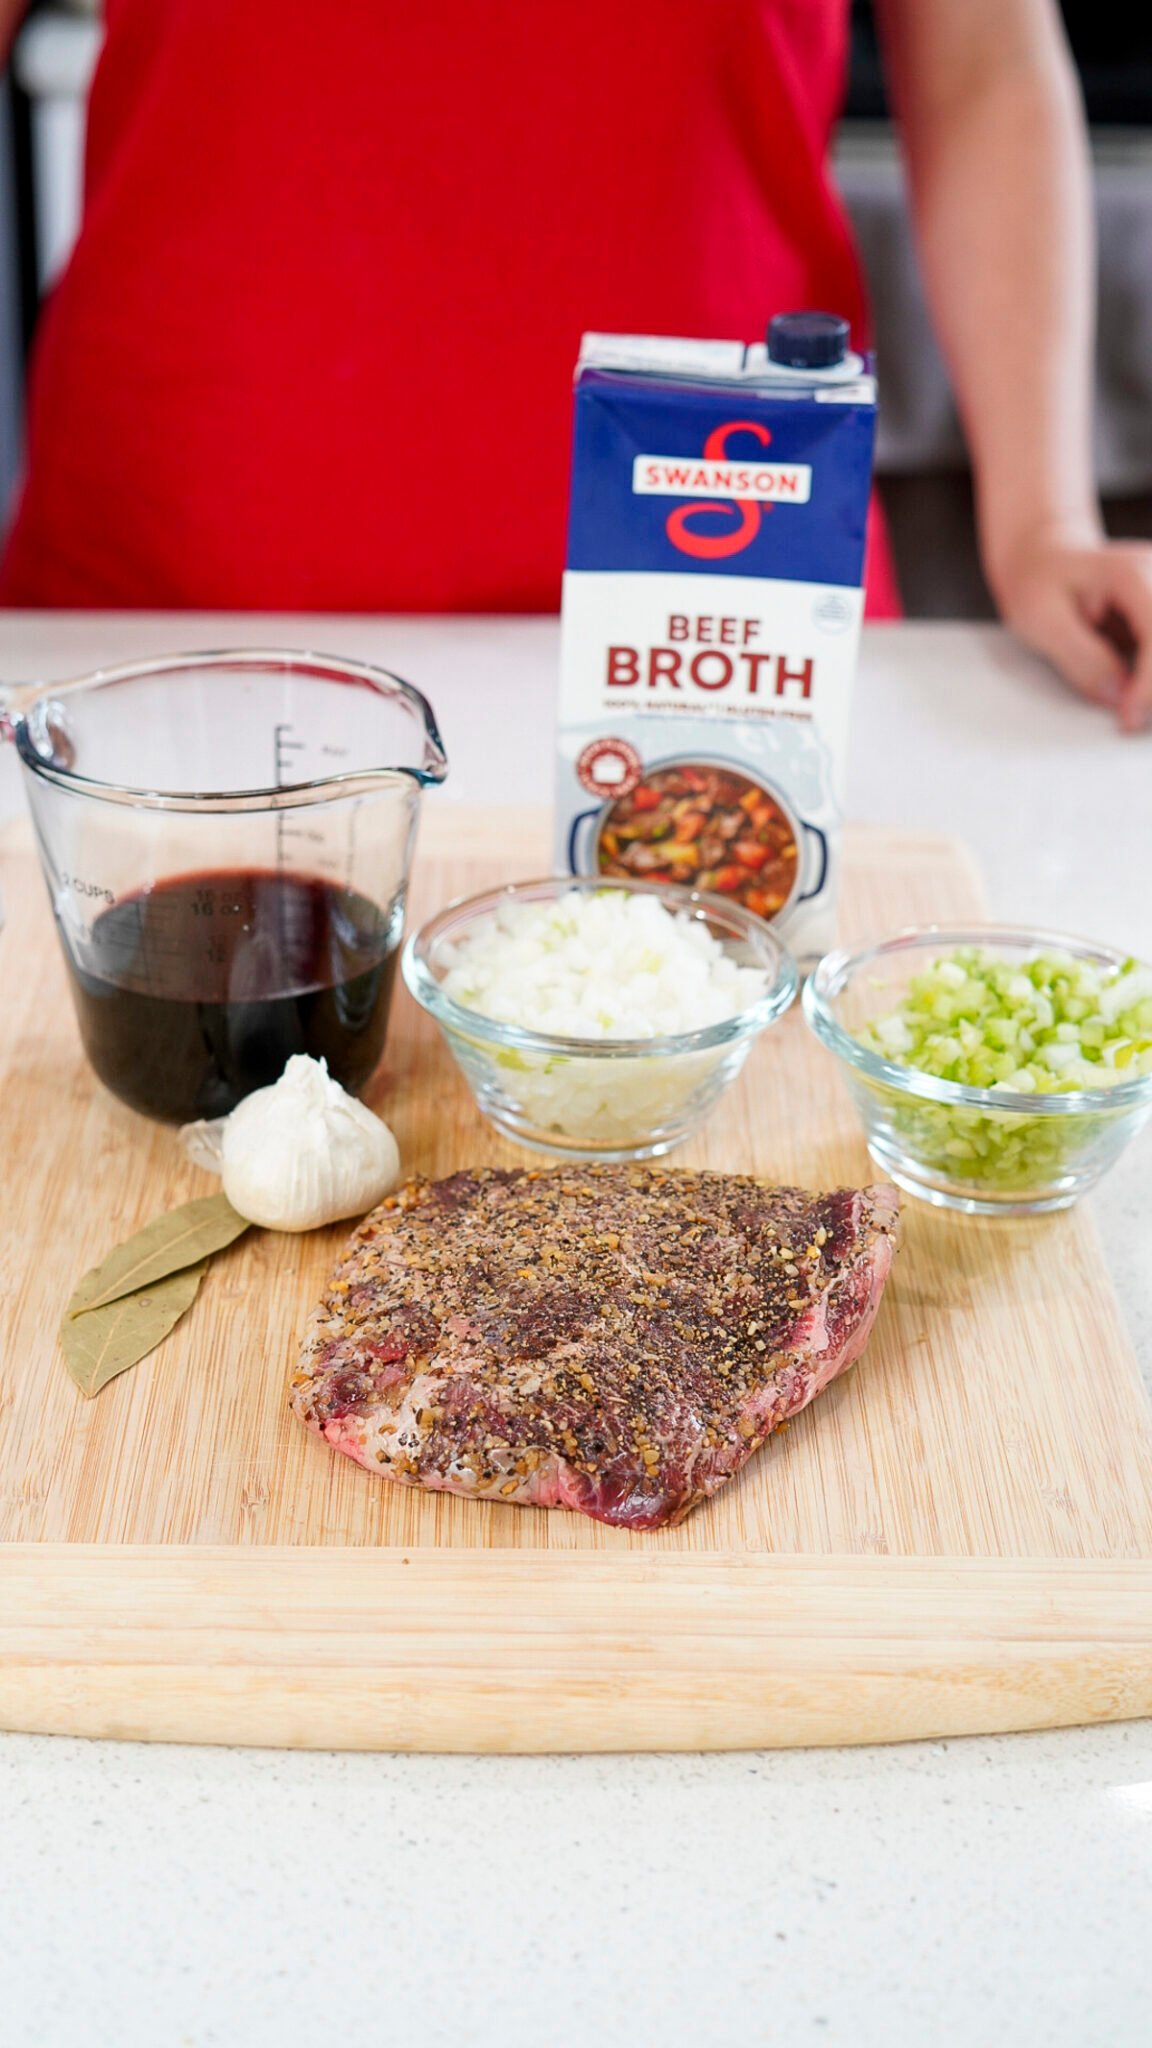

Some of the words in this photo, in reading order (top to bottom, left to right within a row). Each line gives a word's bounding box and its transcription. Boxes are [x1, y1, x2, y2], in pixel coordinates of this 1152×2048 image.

[645, 464, 798, 494] SWANSON
[668, 614, 762, 646] BEEF
[606, 645, 814, 699] BROTH
[72, 878, 115, 905] CUPS
